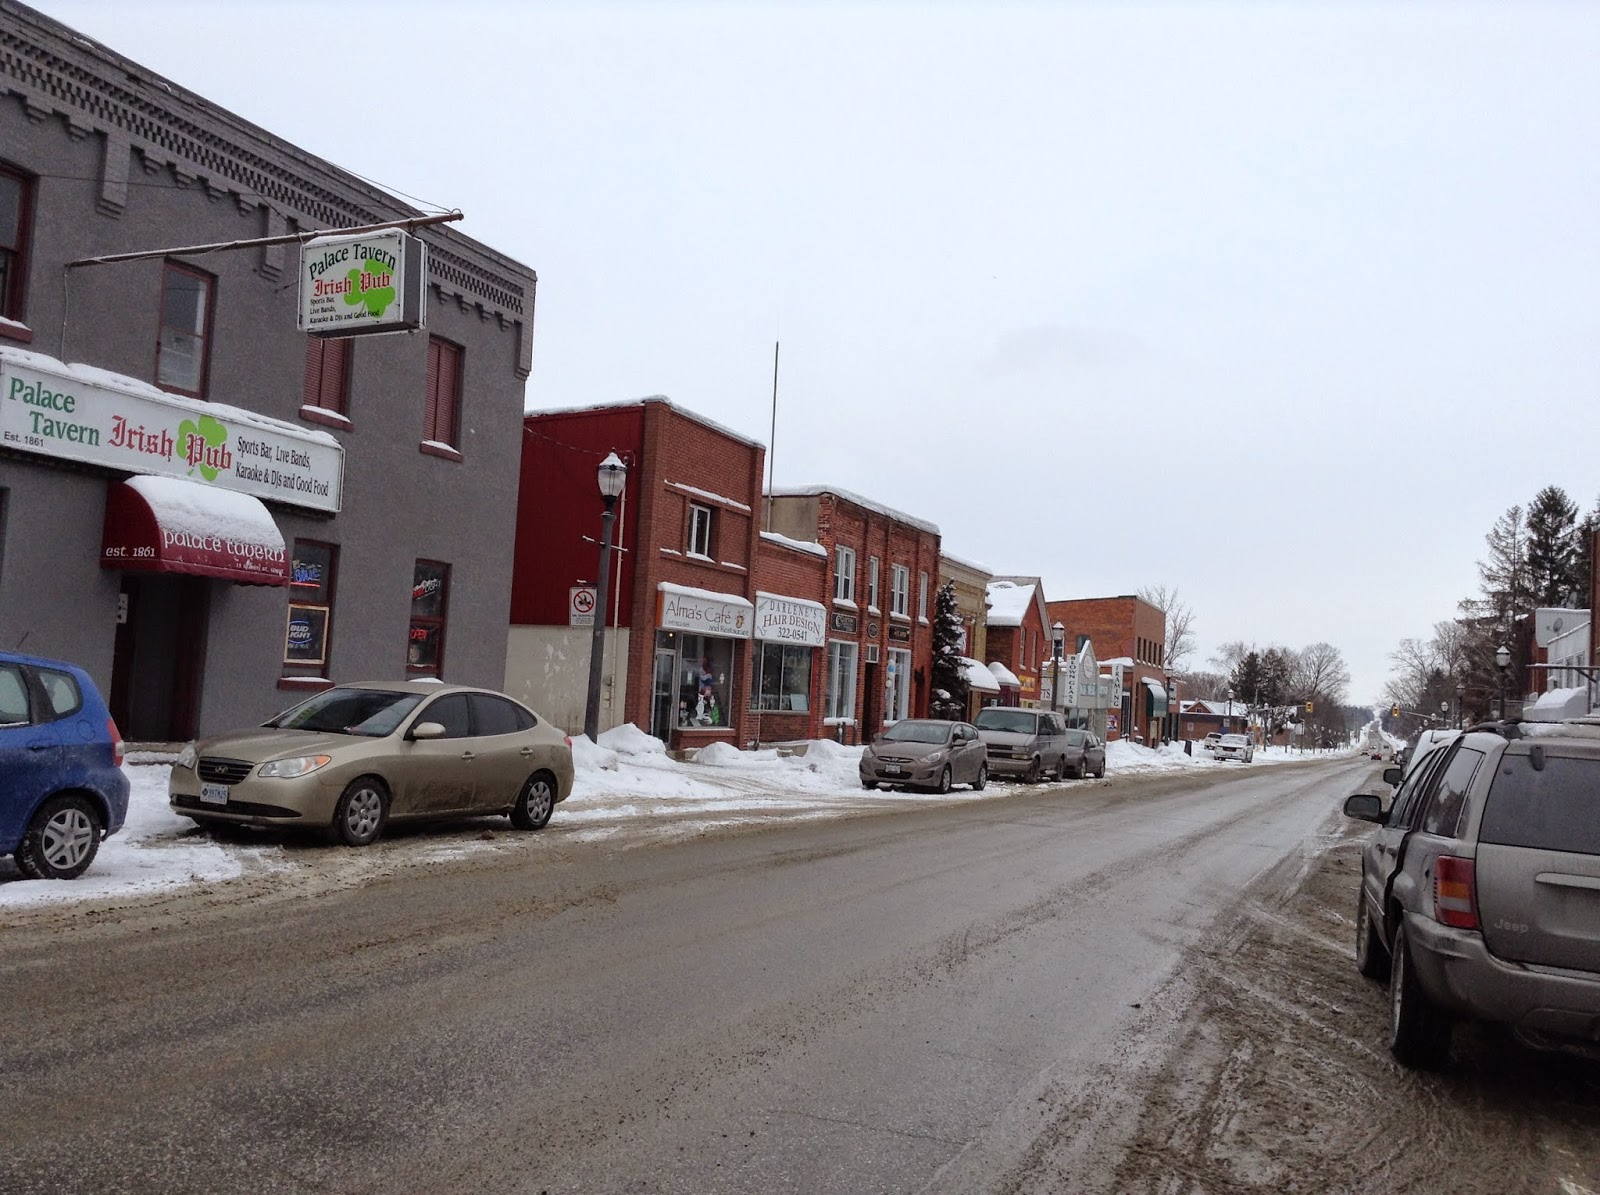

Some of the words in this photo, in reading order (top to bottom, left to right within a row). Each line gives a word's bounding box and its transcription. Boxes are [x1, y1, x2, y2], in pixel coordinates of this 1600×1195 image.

[308, 247, 349, 280] Palace
[353, 243, 396, 271] Tavern
[313, 277, 351, 296] Irish
[360, 271, 390, 292] Pub
[310, 297, 325, 306] Sports
[310, 307, 320, 315] Live
[354, 311, 366, 319] Good
[368, 309, 380, 317] Food
[9, 377, 75, 413] Palace
[4, 431, 21, 442] Est.
[24, 435, 44, 447] 1861
[29, 410, 100, 447] Tavern
[108, 415, 174, 462] Irish
[186, 433, 232, 469] Pub
[237, 436, 259, 458] Sports
[260, 442, 273, 463] Bar,
[275, 446, 290, 463] Live
[291, 450, 311, 471] Bands,
[235, 461, 263, 482] Karaoke
[263, 468, 269, 483] &
[271, 470, 282, 489] DJs
[283, 473, 295, 490] and
[296, 476, 312, 493] Good
[313, 480, 329, 496] Food
[105, 547, 128, 557] est.
[132, 545, 156, 558] 1861
[163, 529, 222, 552] palace
[665, 597, 702, 620] Alma's
[704, 604, 731, 624] Café
[770, 600, 817, 619] DARLENE'S
[709, 624, 720, 632] and
[720, 625, 749, 636] Restaurant
[763, 613, 787, 627] HAIR
[789, 615, 820, 636] DESIGN
[777, 627, 808, 641] 322-0541
[1069, 656, 1077, 679] BLOWN
[1113, 666, 1121, 707] FRAMING
[1494, 919, 1529, 934] Jeep
